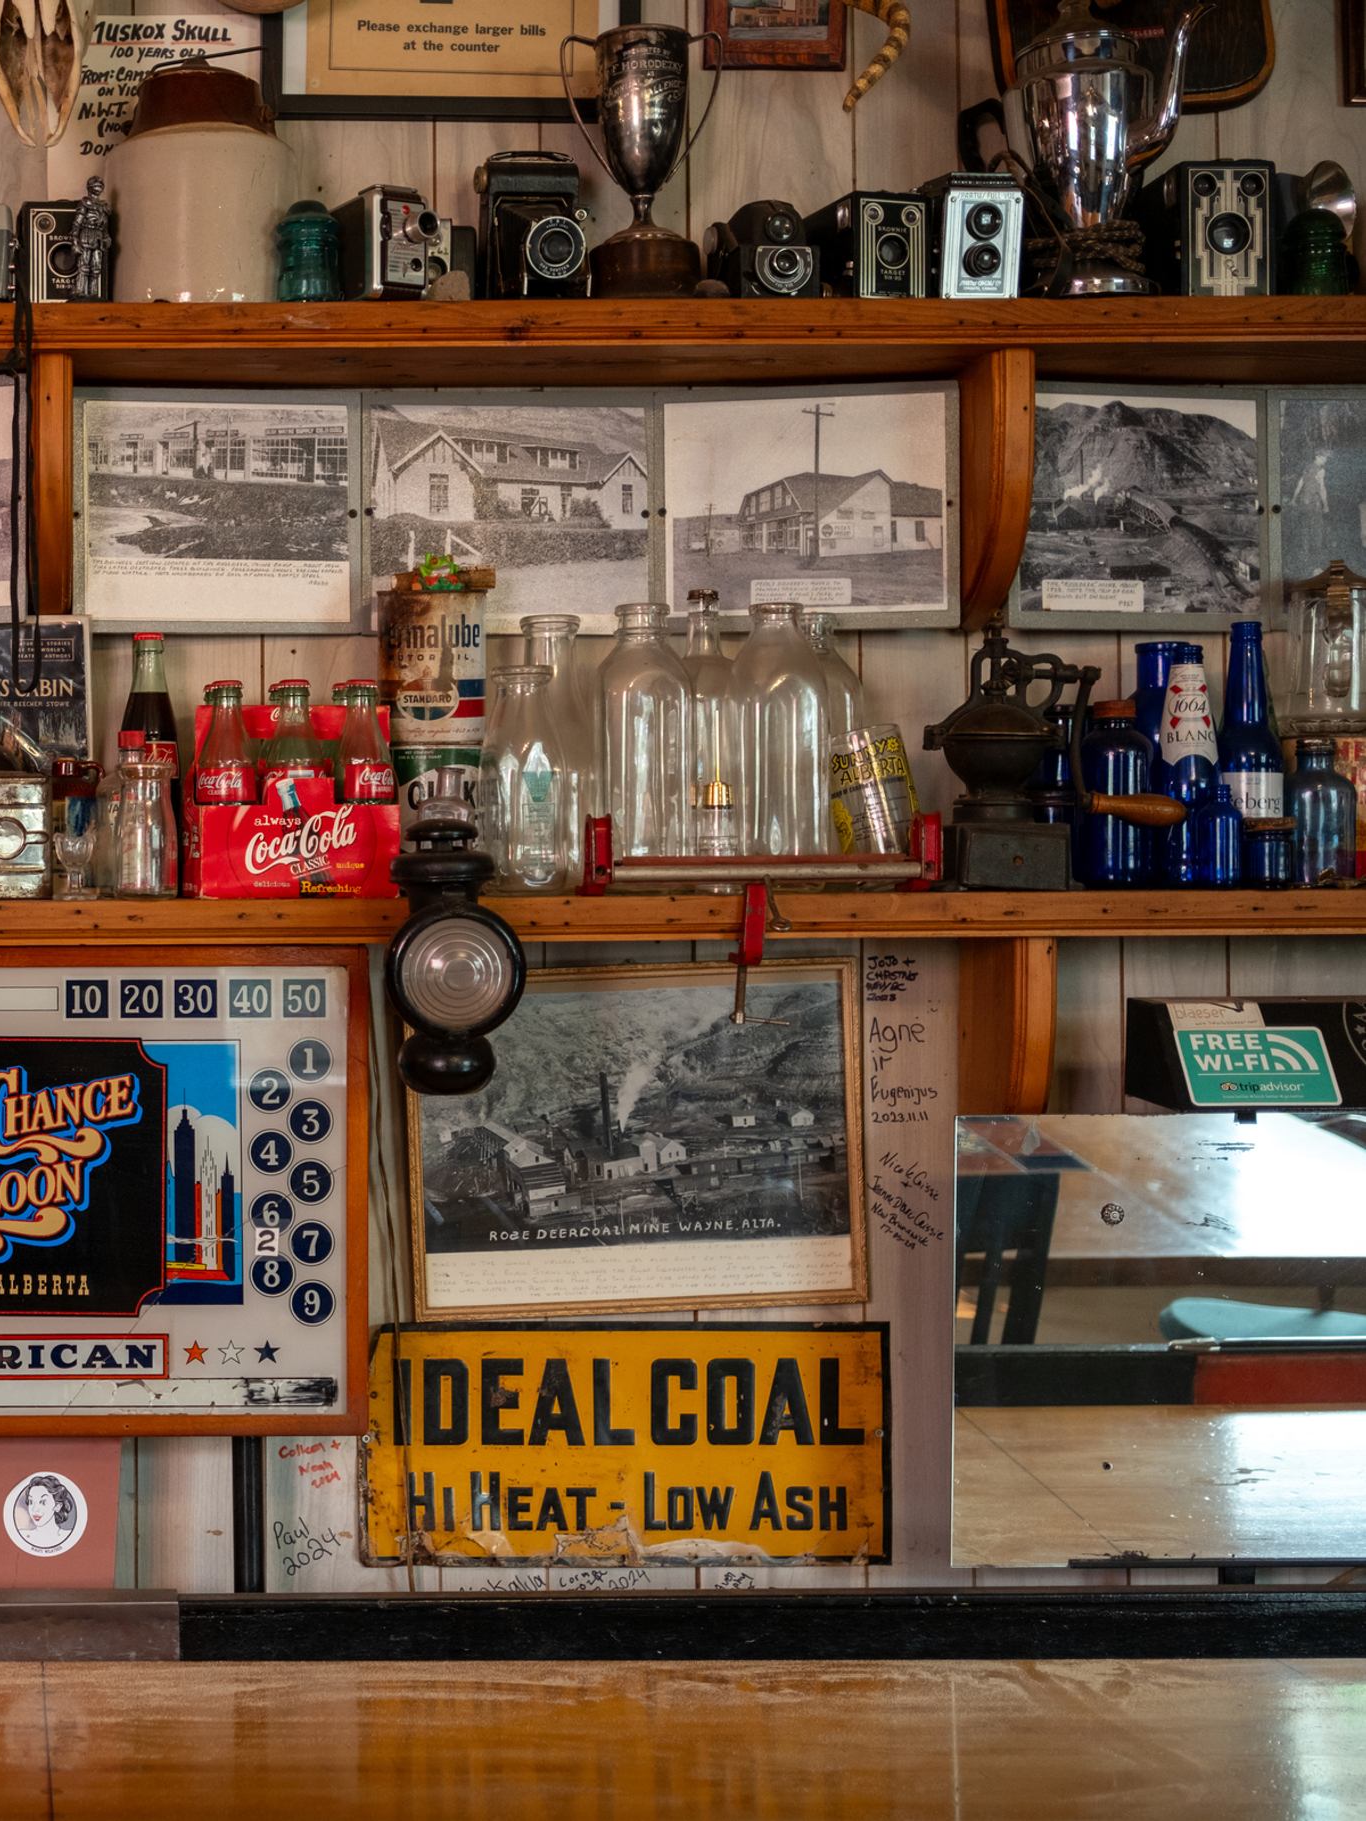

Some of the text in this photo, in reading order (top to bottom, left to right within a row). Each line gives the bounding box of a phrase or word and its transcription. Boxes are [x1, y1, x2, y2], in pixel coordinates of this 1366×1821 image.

[171, 20, 231, 42] SKULL
[357, 20, 546, 37] Please exchange larger bills
[110, 46, 175, 63] 100 YEARS
[403, 40, 500, 53] at the counter
[78, 101, 129, 120] N.W.T.
[880, 269, 907, 277] TARGET
[403, 693, 452, 704] STANDARD
[1174, 697, 1207, 715] 1664
[1167, 731, 1215, 745] BLANC
[198, 769, 243, 791] Coca-Cola
[254, 815, 301, 827] always
[244, 804, 357, 876] Coca-Cola
[290, 854, 331, 876] CLASSIC
[336, 861, 365, 872] unique
[253, 880, 291, 889] delicious
[300, 880, 363, 897] Refreshing
[71, 984, 102, 1015] 10
[124, 984, 160, 1014] 20
[178, 984, 213, 1014] 30
[233, 984, 269, 1014] 40
[286, 984, 321, 1013] 50
[1189, 1033, 1263, 1051] FREE
[303, 1047, 318, 1074] 1
[1195, 1053, 1271, 1072] WI-FI
[260, 1077, 281, 1105] 2
[870, 1075, 939, 1108] Eugenijus
[1239, 1080, 1302, 1092] tripadvisor
[301, 1108, 320, 1135] 3
[872, 1111, 929, 1124] 2023.11.11
[259, 1139, 280, 1166] 4
[302, 1169, 320, 1197] 5
[263, 1201, 280, 1229] 6
[628, 1221, 671, 1236] MINE
[259, 1229, 276, 1253] 2
[302, 1229, 321, 1257] 7
[263, 1262, 281, 1289] 8
[303, 1289, 321, 1317] 9
[393, 1358, 866, 1446] IDEAL COAL
[408, 1470, 848, 1532] HI HEAT LOW ASH
[273, 1516, 310, 1550] Paul
[282, 1527, 341, 1577] 2024
